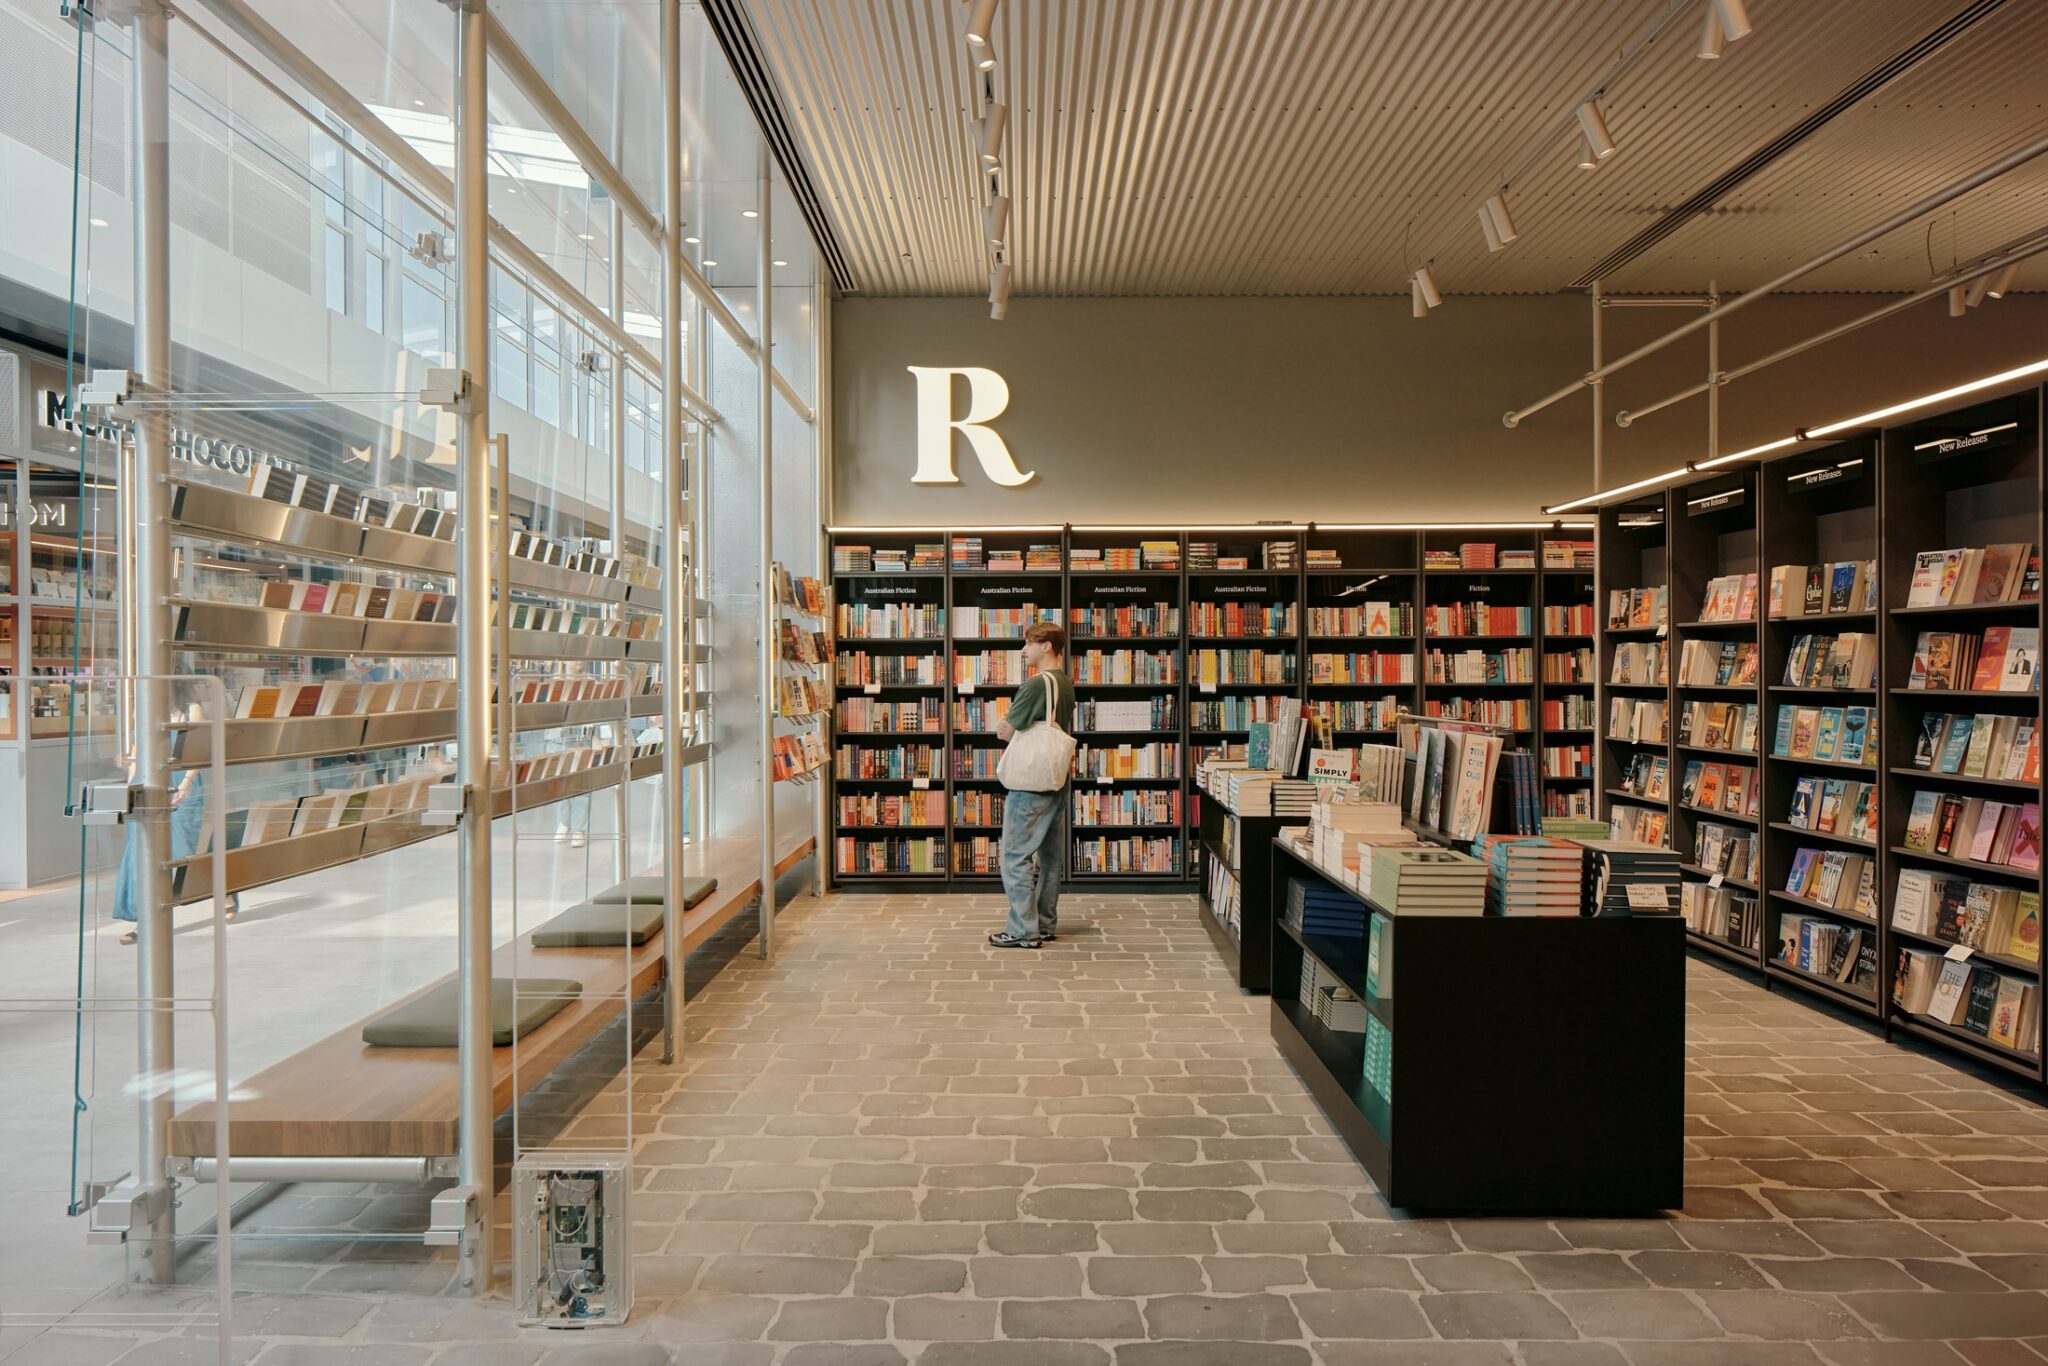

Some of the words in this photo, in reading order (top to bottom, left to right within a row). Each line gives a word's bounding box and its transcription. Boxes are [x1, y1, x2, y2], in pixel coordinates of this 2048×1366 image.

[907, 366, 1035, 486] R
[1939, 441, 1955, 453] New
[1956, 434, 1988, 450] Releases
[1805, 474, 1818, 485] New
[1818, 469, 1842, 482] Releases
[1700, 500, 1710, 509] New
[1710, 496, 1728, 507] Releases
[1314, 767, 1348, 777] SIMPLY
[1939, 927, 1957, 938] GRANT
[1861, 946, 1877, 960] ONYX
[1858, 958, 1876, 973] STORM
[1945, 969, 1962, 987] THE
